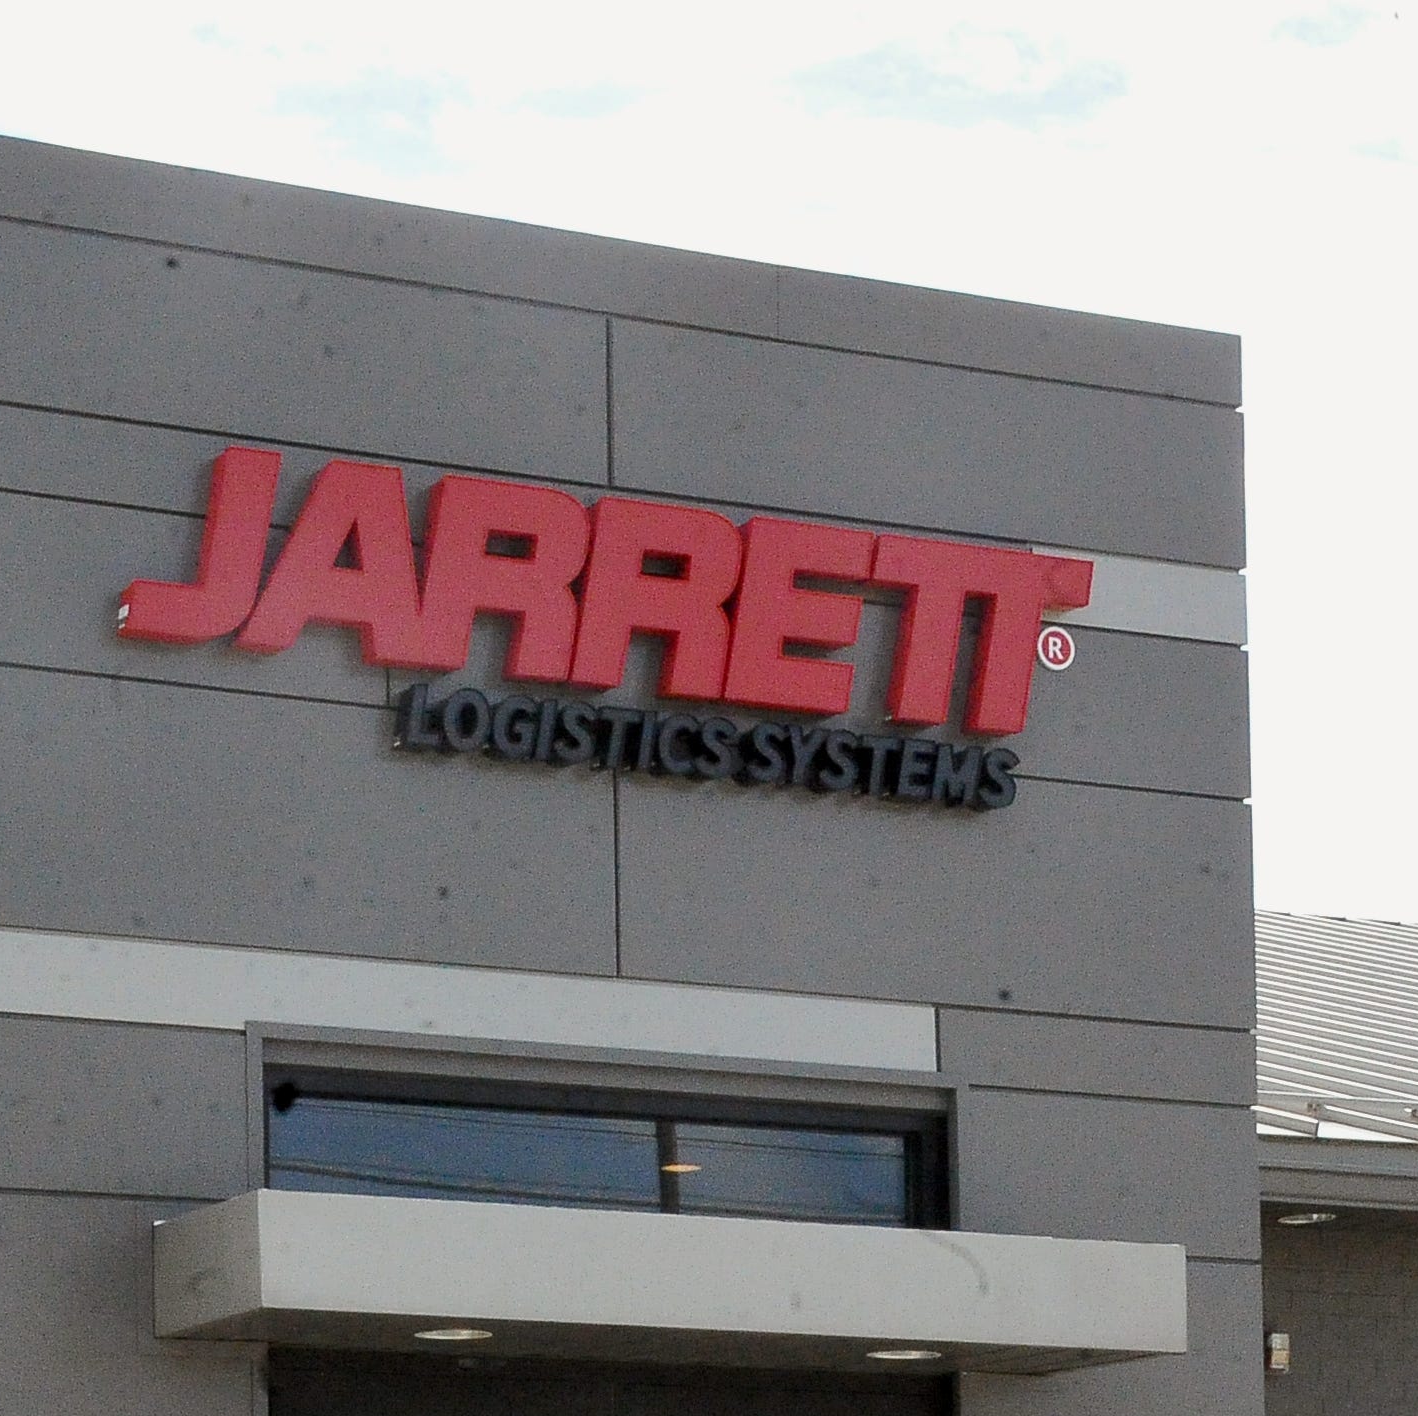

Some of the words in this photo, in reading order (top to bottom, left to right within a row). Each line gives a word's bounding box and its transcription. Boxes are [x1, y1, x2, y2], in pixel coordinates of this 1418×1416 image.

[117, 445, 1094, 737] JARRETT
[395, 683, 744, 780] LOGISTICS
[735, 721, 1020, 811] SYSTEMS
